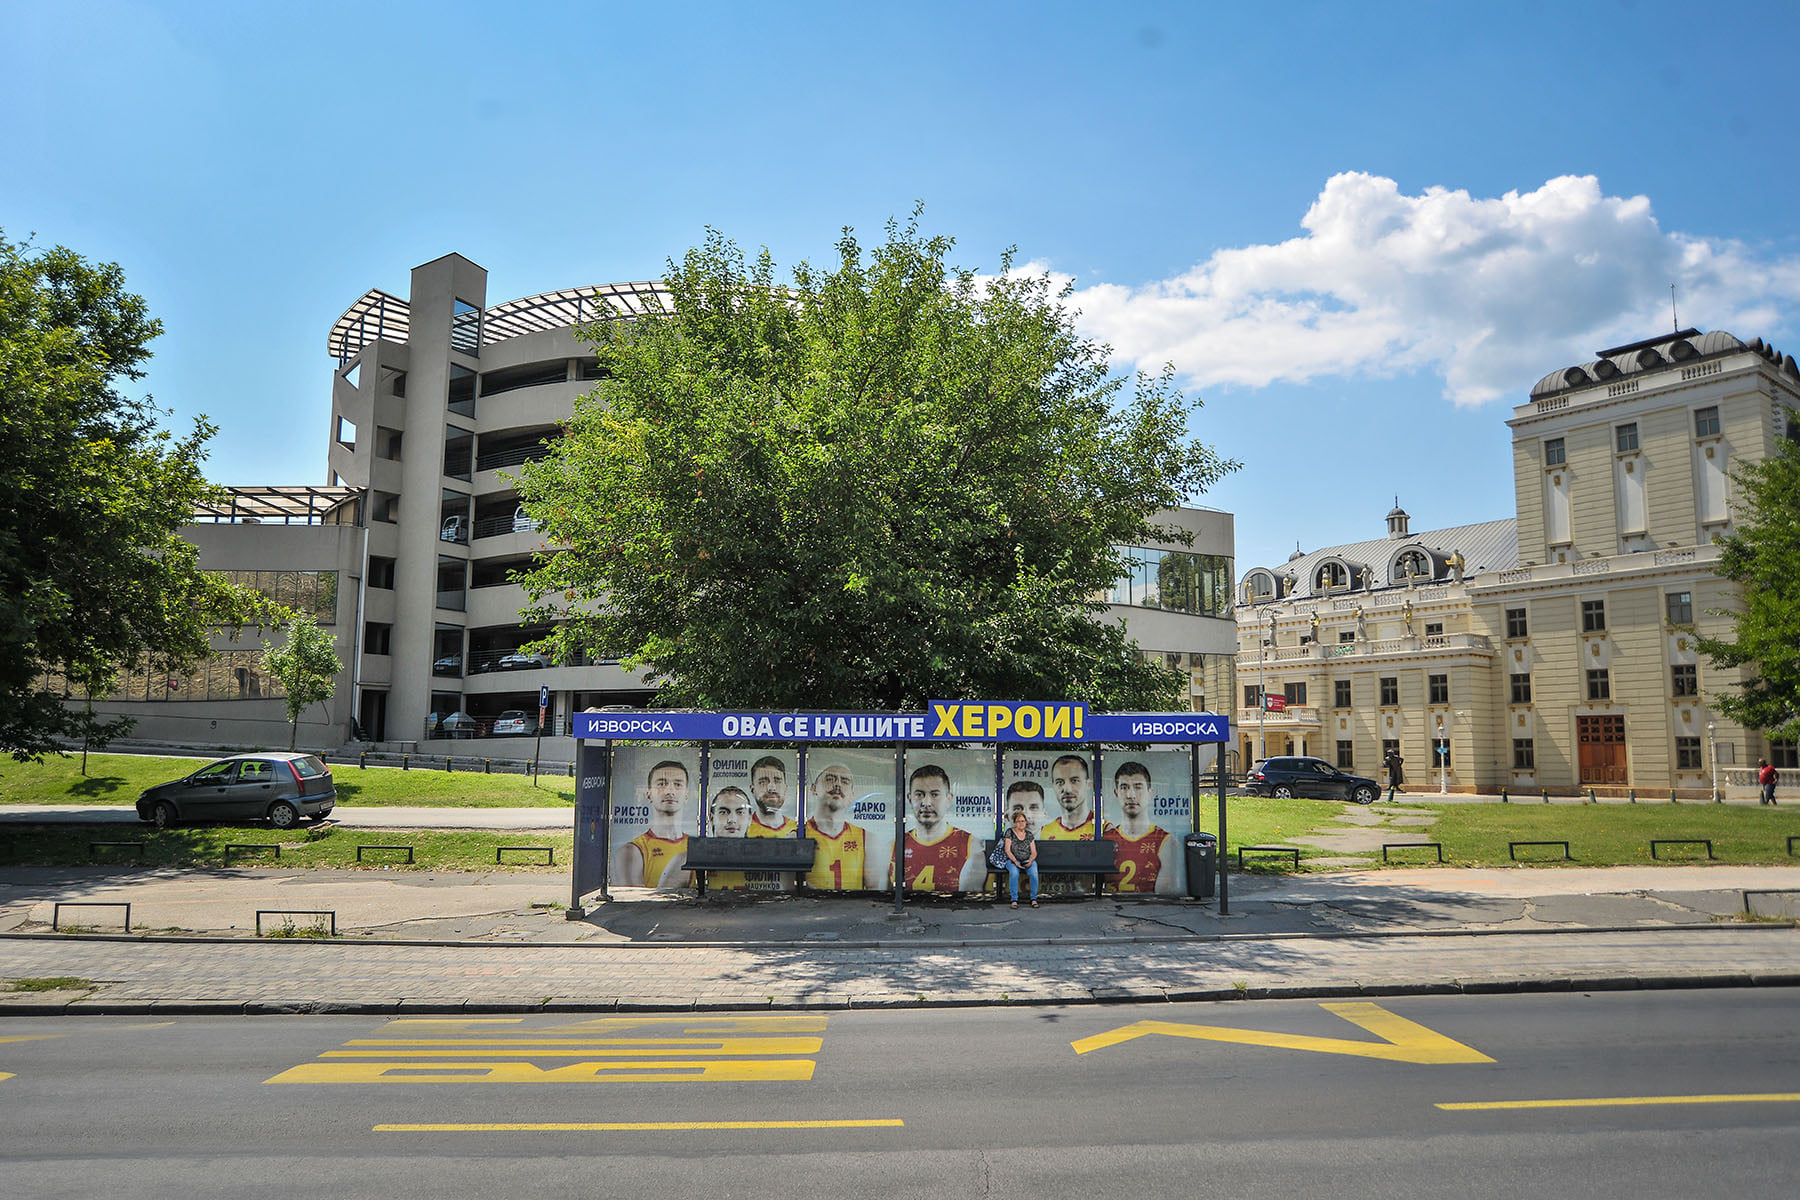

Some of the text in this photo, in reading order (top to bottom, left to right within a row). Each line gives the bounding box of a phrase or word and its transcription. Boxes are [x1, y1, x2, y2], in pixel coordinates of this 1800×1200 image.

[541, 687, 547, 705] P
[588, 719, 674, 733] ИЗВОРСКА
[722, 704, 1084, 739] ОВА СЕ НАШИТЕ ХЕРОИ!
[1131, 722, 1219, 736] ИЗВОРСКА
[712, 759, 748, 770] ФИЛИП
[1013, 759, 1049, 771] ВЛАДО
[1013, 770, 1049, 778] МИЛЕВ
[955, 796, 992, 806] НИКОЛА
[614, 806, 649, 817] РИСТО
[853, 802, 886, 814] ДАРКО
[1153, 808, 1190, 816] ГОРГИЕВ
[613, 817, 649, 825] НИКОЛОВ
[853, 813, 886, 821] АНГЕЛОВСКИ
[829, 859, 842, 891] 1
[912, 865, 936, 891] 4
[1119, 859, 1137, 891] 2
